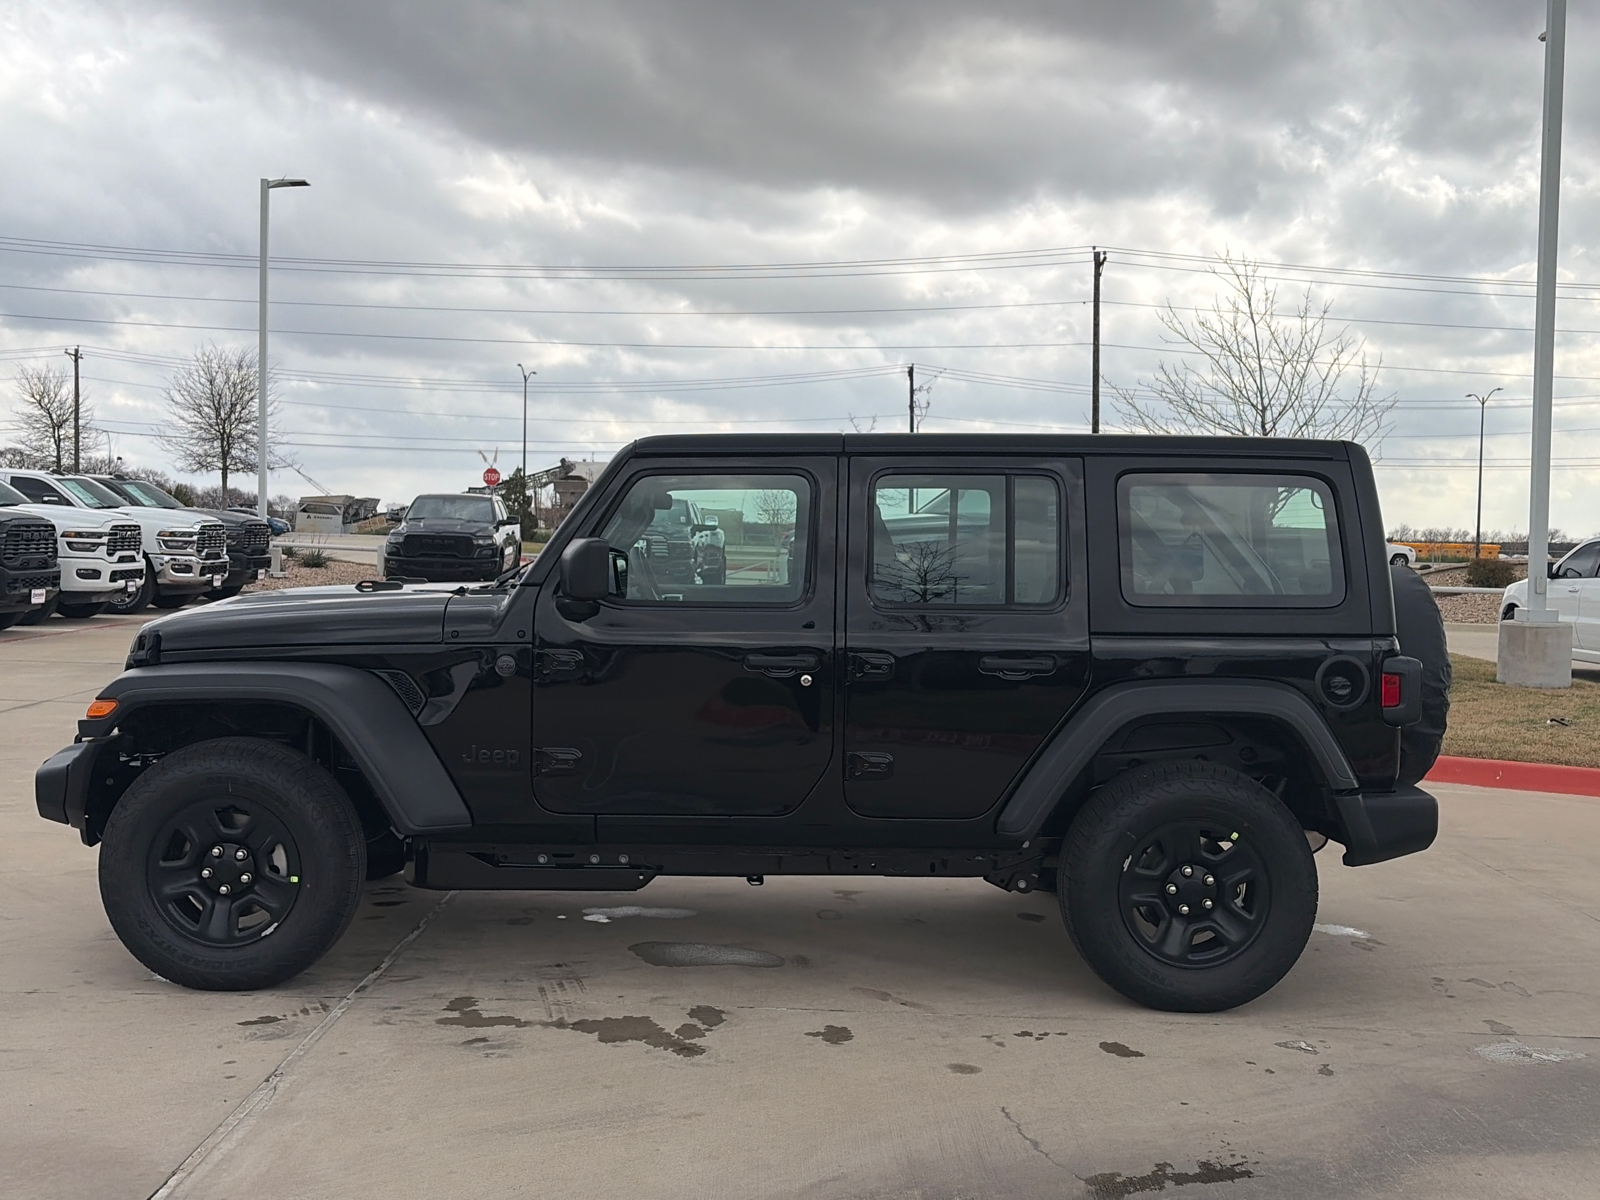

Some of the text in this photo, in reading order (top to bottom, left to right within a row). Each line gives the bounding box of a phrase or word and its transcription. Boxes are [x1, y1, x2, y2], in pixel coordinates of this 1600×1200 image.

[484, 473, 499, 481] STOP
[25, 532, 49, 540] RAM
[461, 744, 520, 767] Jeep
